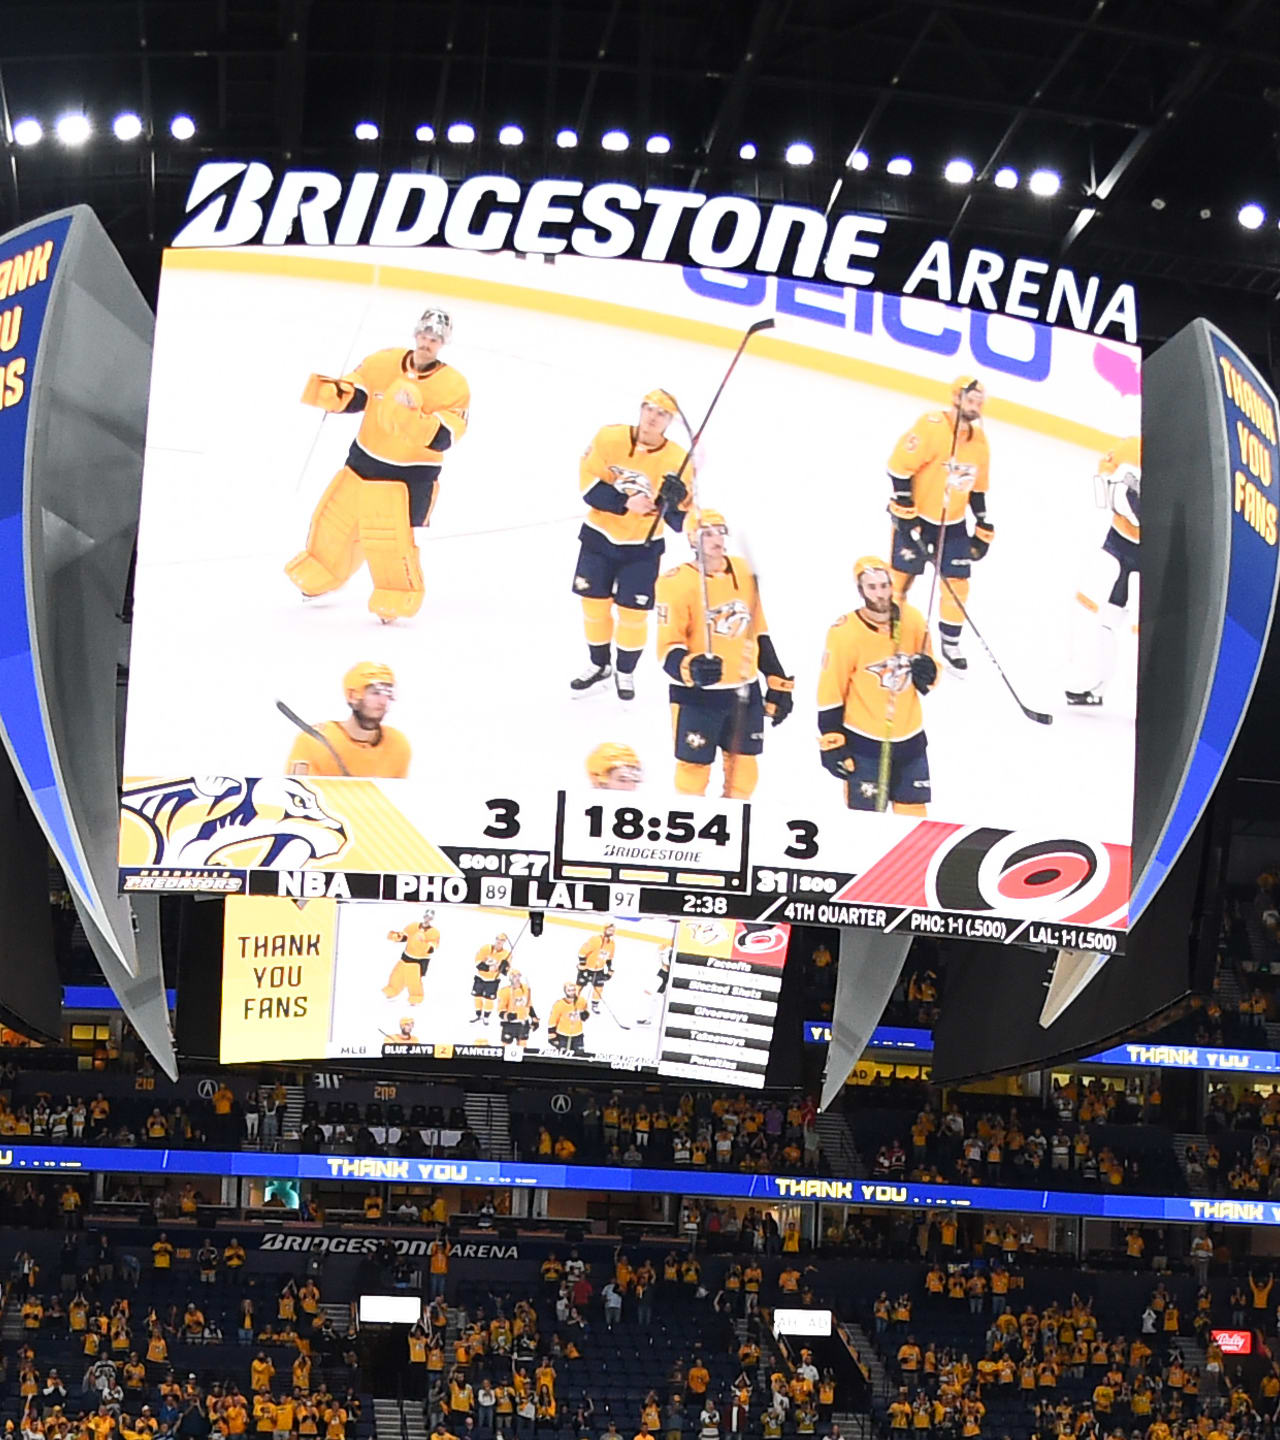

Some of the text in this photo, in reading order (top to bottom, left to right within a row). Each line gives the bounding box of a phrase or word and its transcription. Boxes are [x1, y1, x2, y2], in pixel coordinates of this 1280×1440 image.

[172, 162, 1139, 342] BRIDGESTONE ARENA
[1218, 355, 1277, 445] THANK
[1236, 419, 1272, 487] YOU
[1234, 470, 1278, 546] FANS
[483, 798, 521, 839] 3
[584, 804, 731, 847] 18:54
[784, 819, 819, 860] 3
[509, 853, 550, 877] 27
[604, 845, 703, 864] BRIDGESTONE
[123, 876, 242, 892] PREDATORS
[278, 871, 351, 899] NBA
[756, 870, 787, 894] 31
[395, 876, 728, 914] PHO 89 LAL 97 2:38
[784, 902, 886, 928] 4TH QUARTER
[910, 913, 945, 933] PHO:
[965, 919, 1008, 940] (.500)
[238, 934, 321, 958] THANK
[1029, 926, 1060, 945] LAL:
[1078, 932, 1117, 951] (.500)
[253, 966, 302, 989] YOU
[244, 997, 308, 1020] FANS
[340, 1045, 367, 1055] MLB
[384, 1044, 409, 1055] BLUE
[455, 1046, 503, 1058] YANKEES
[1127, 1045, 1250, 1068] THANK YOU
[327, 1158, 468, 1181] THANK YOU
[775, 1178, 907, 1202] THANK YOU
[1191, 1201, 1264, 1220] THANK
[447, 1243, 519, 1259] ARENA
